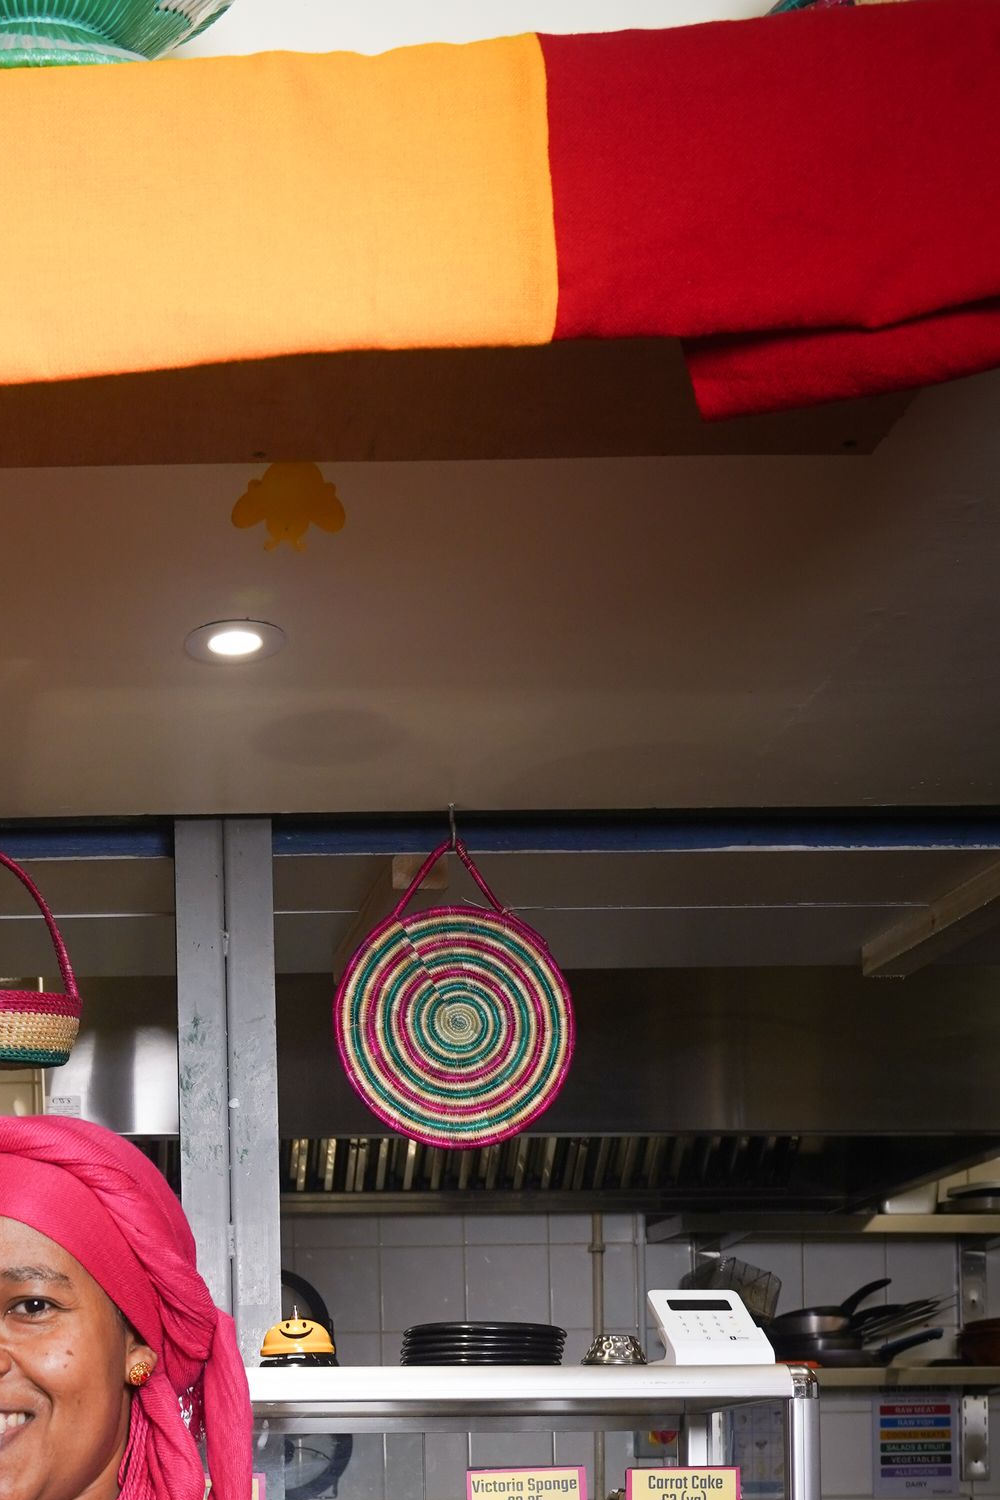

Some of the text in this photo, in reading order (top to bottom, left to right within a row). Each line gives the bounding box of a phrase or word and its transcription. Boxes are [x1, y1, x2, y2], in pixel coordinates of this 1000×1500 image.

[471, 1476, 578, 1494] Victoria Sponge
[648, 1475, 723, 1490] Carrot Cake
